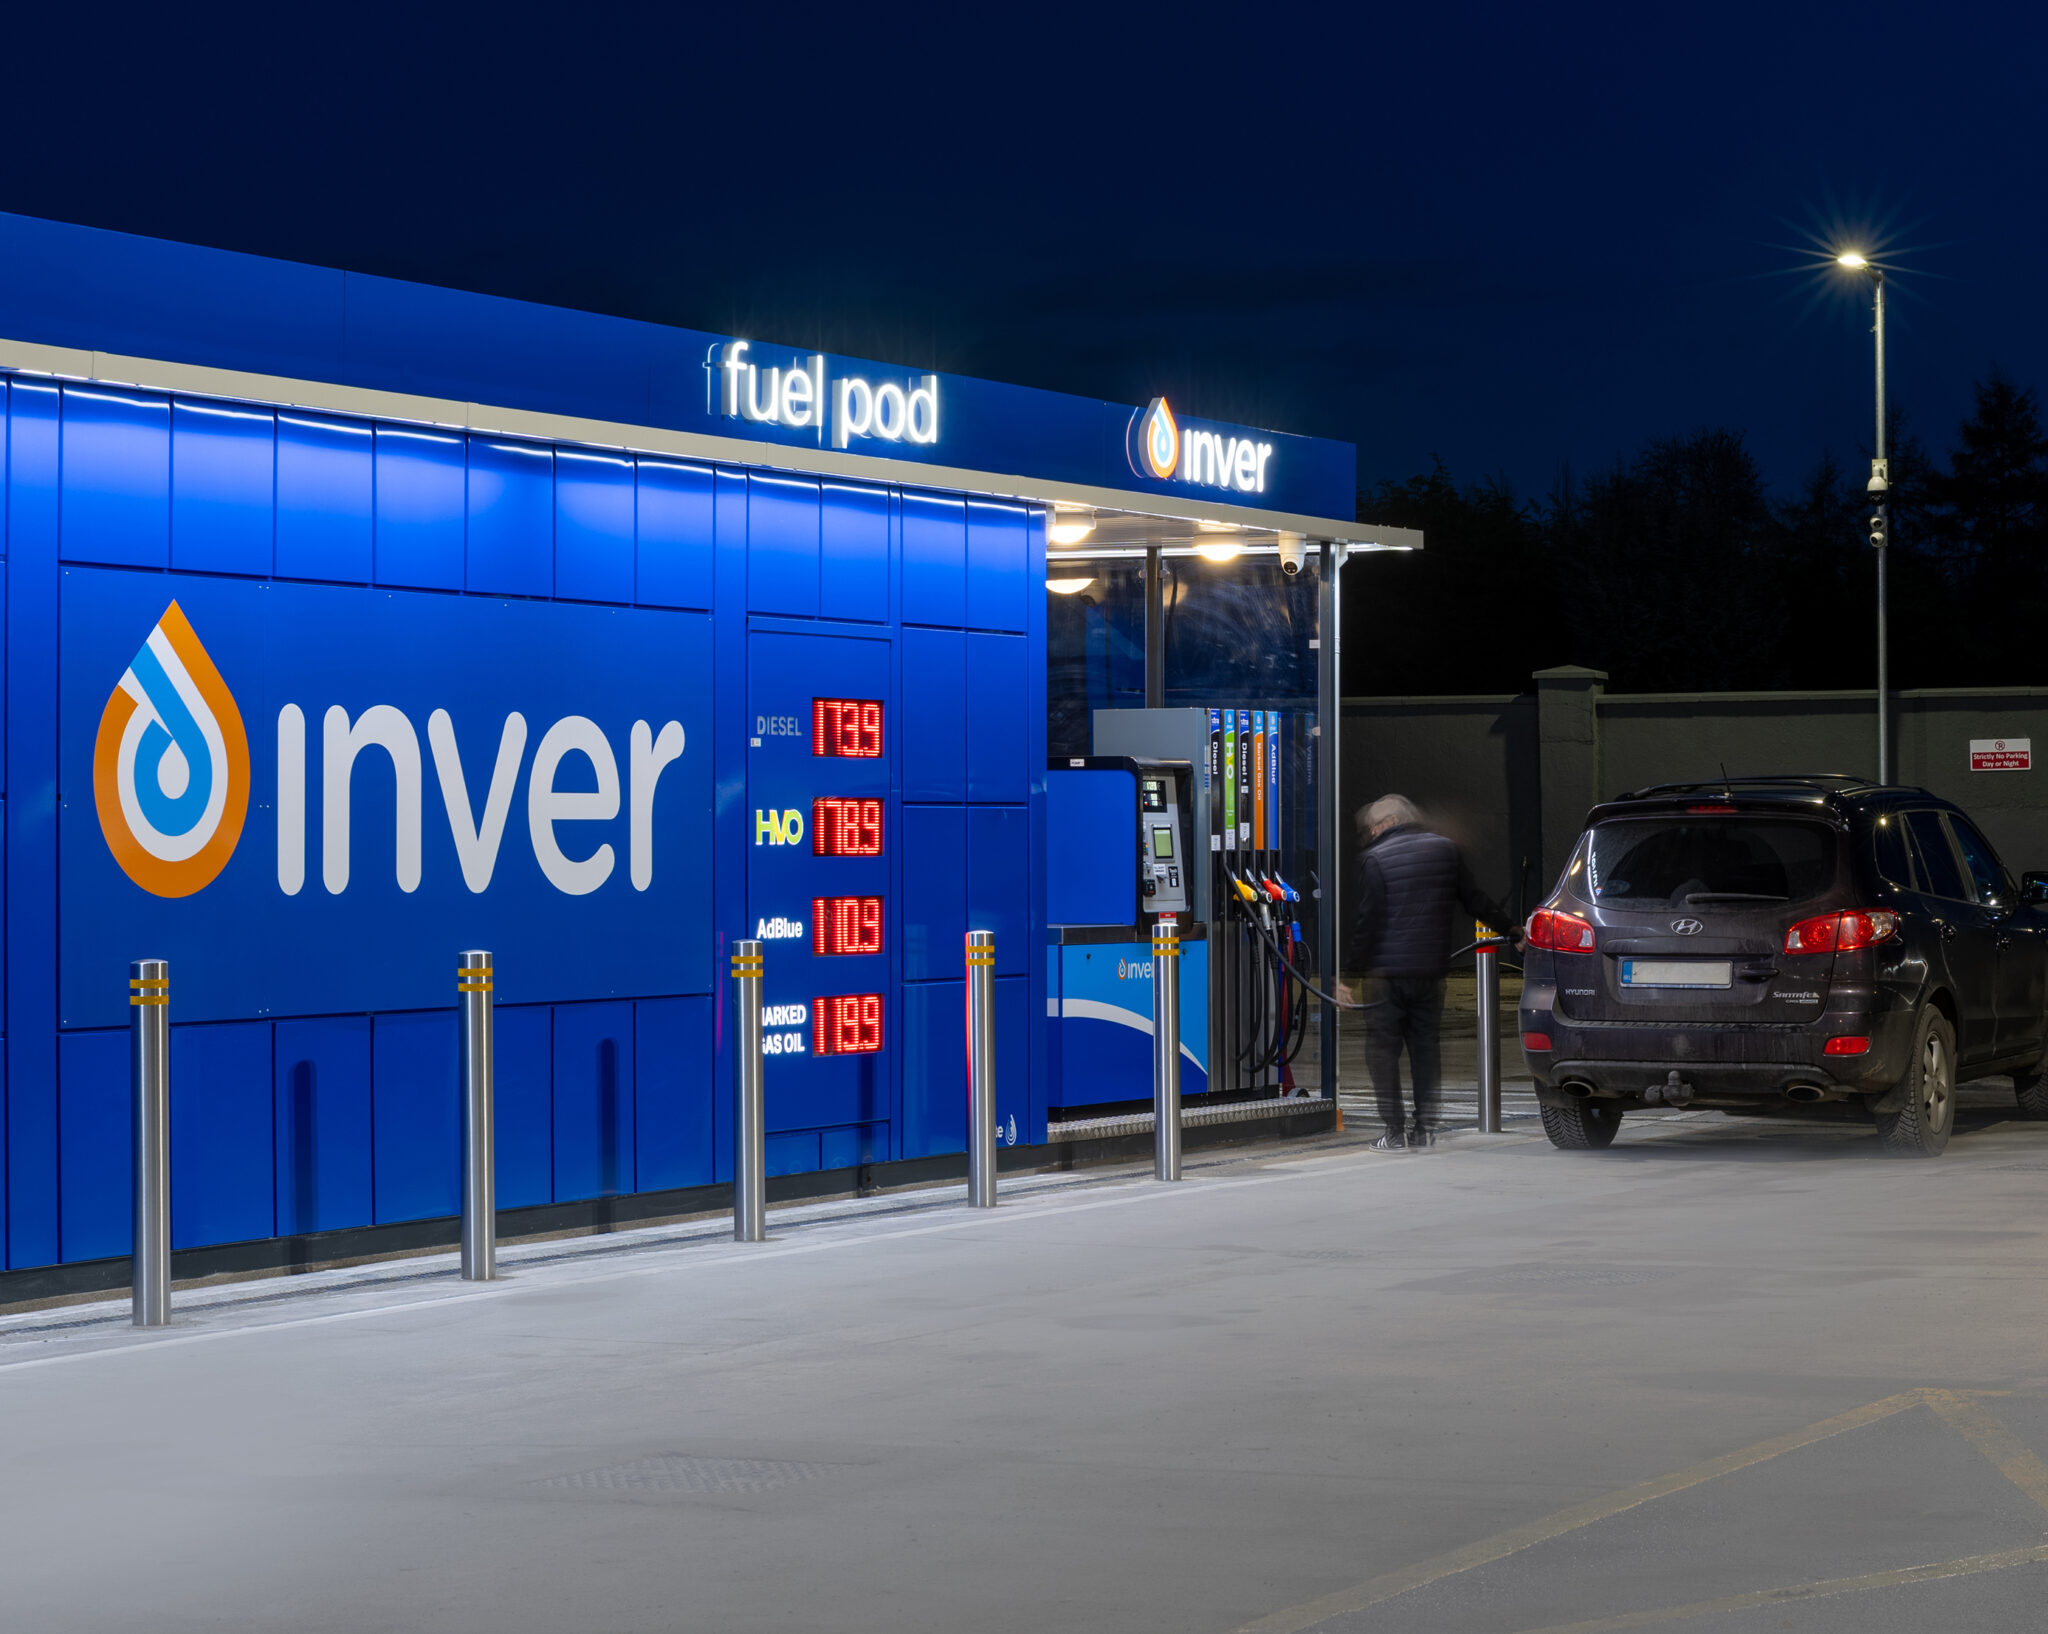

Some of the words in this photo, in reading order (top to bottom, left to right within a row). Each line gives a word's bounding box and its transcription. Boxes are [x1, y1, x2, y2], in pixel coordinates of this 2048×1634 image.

[722, 340, 823, 427] fuel
[833, 374, 937, 449] pod
[1183, 428, 1272, 493] inver
[756, 715, 802, 736] DIESEL
[1226, 742, 1234, 780] HVO
[277, 702, 686, 896] inver
[755, 809, 804, 845] HVO
[756, 917, 803, 940] AdBlue
[783, 1032, 805, 1053] OIL
